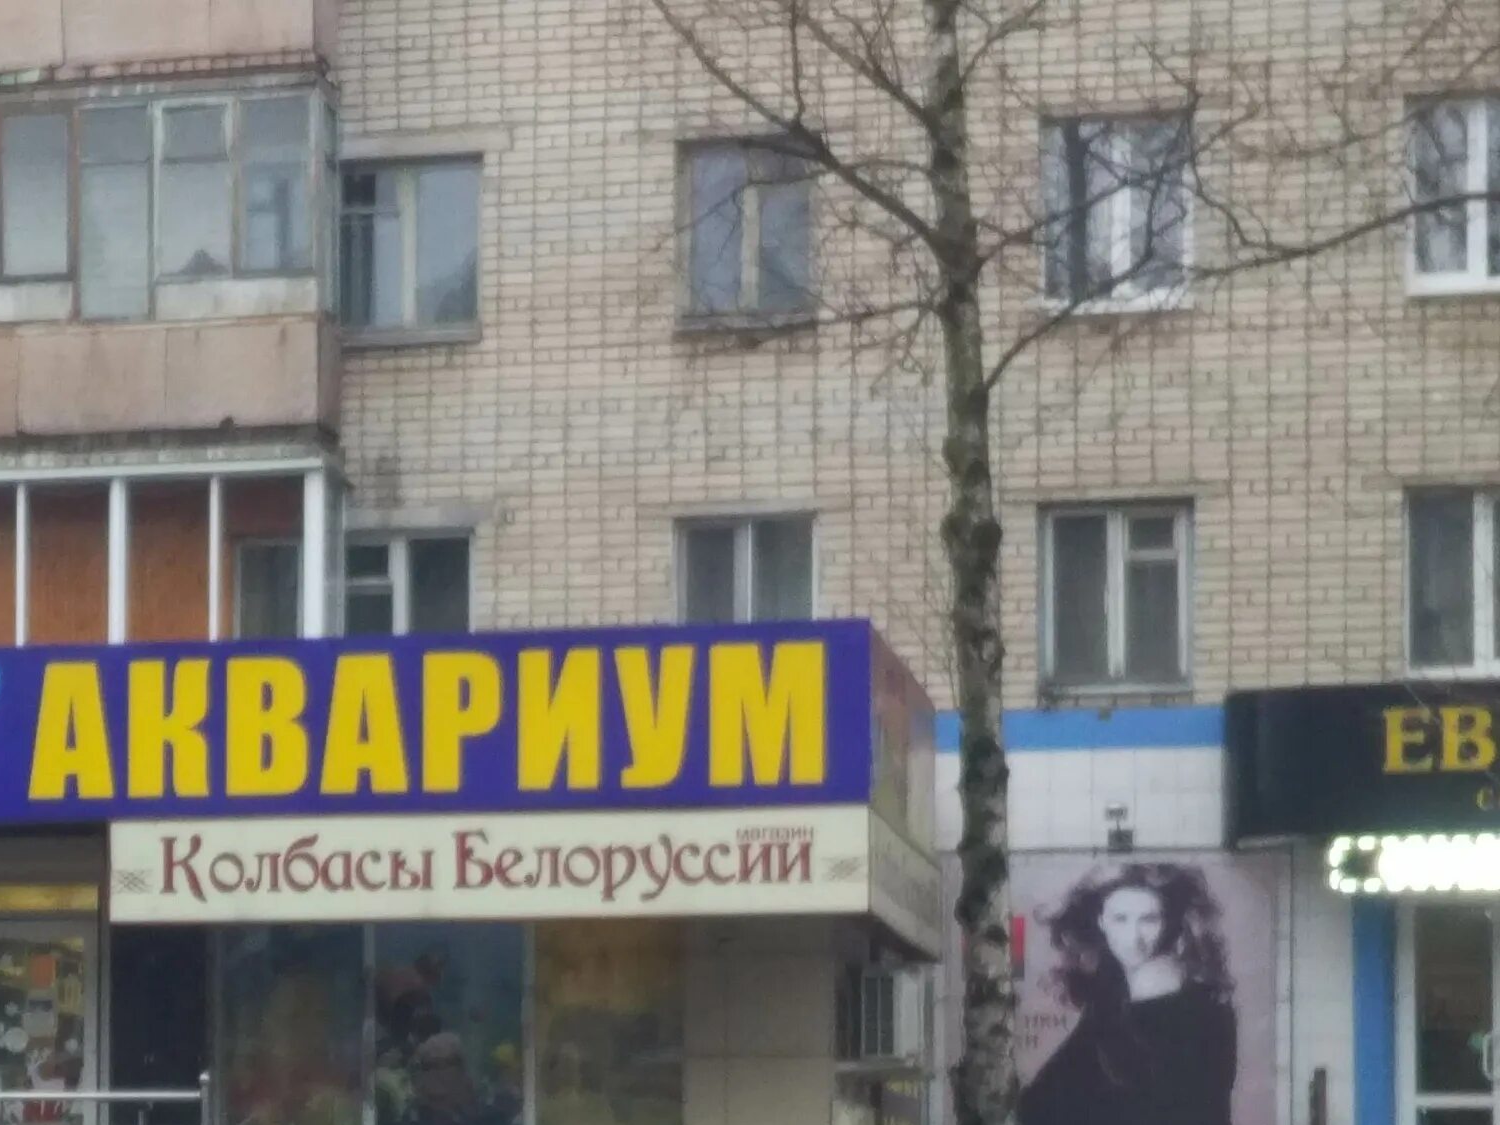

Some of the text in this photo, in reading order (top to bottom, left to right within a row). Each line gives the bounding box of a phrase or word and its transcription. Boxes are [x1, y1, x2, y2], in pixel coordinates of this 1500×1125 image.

[28, 640, 826, 799] АКВАРИУМ
[158, 828, 813, 902] Колбасы Белоруссии
